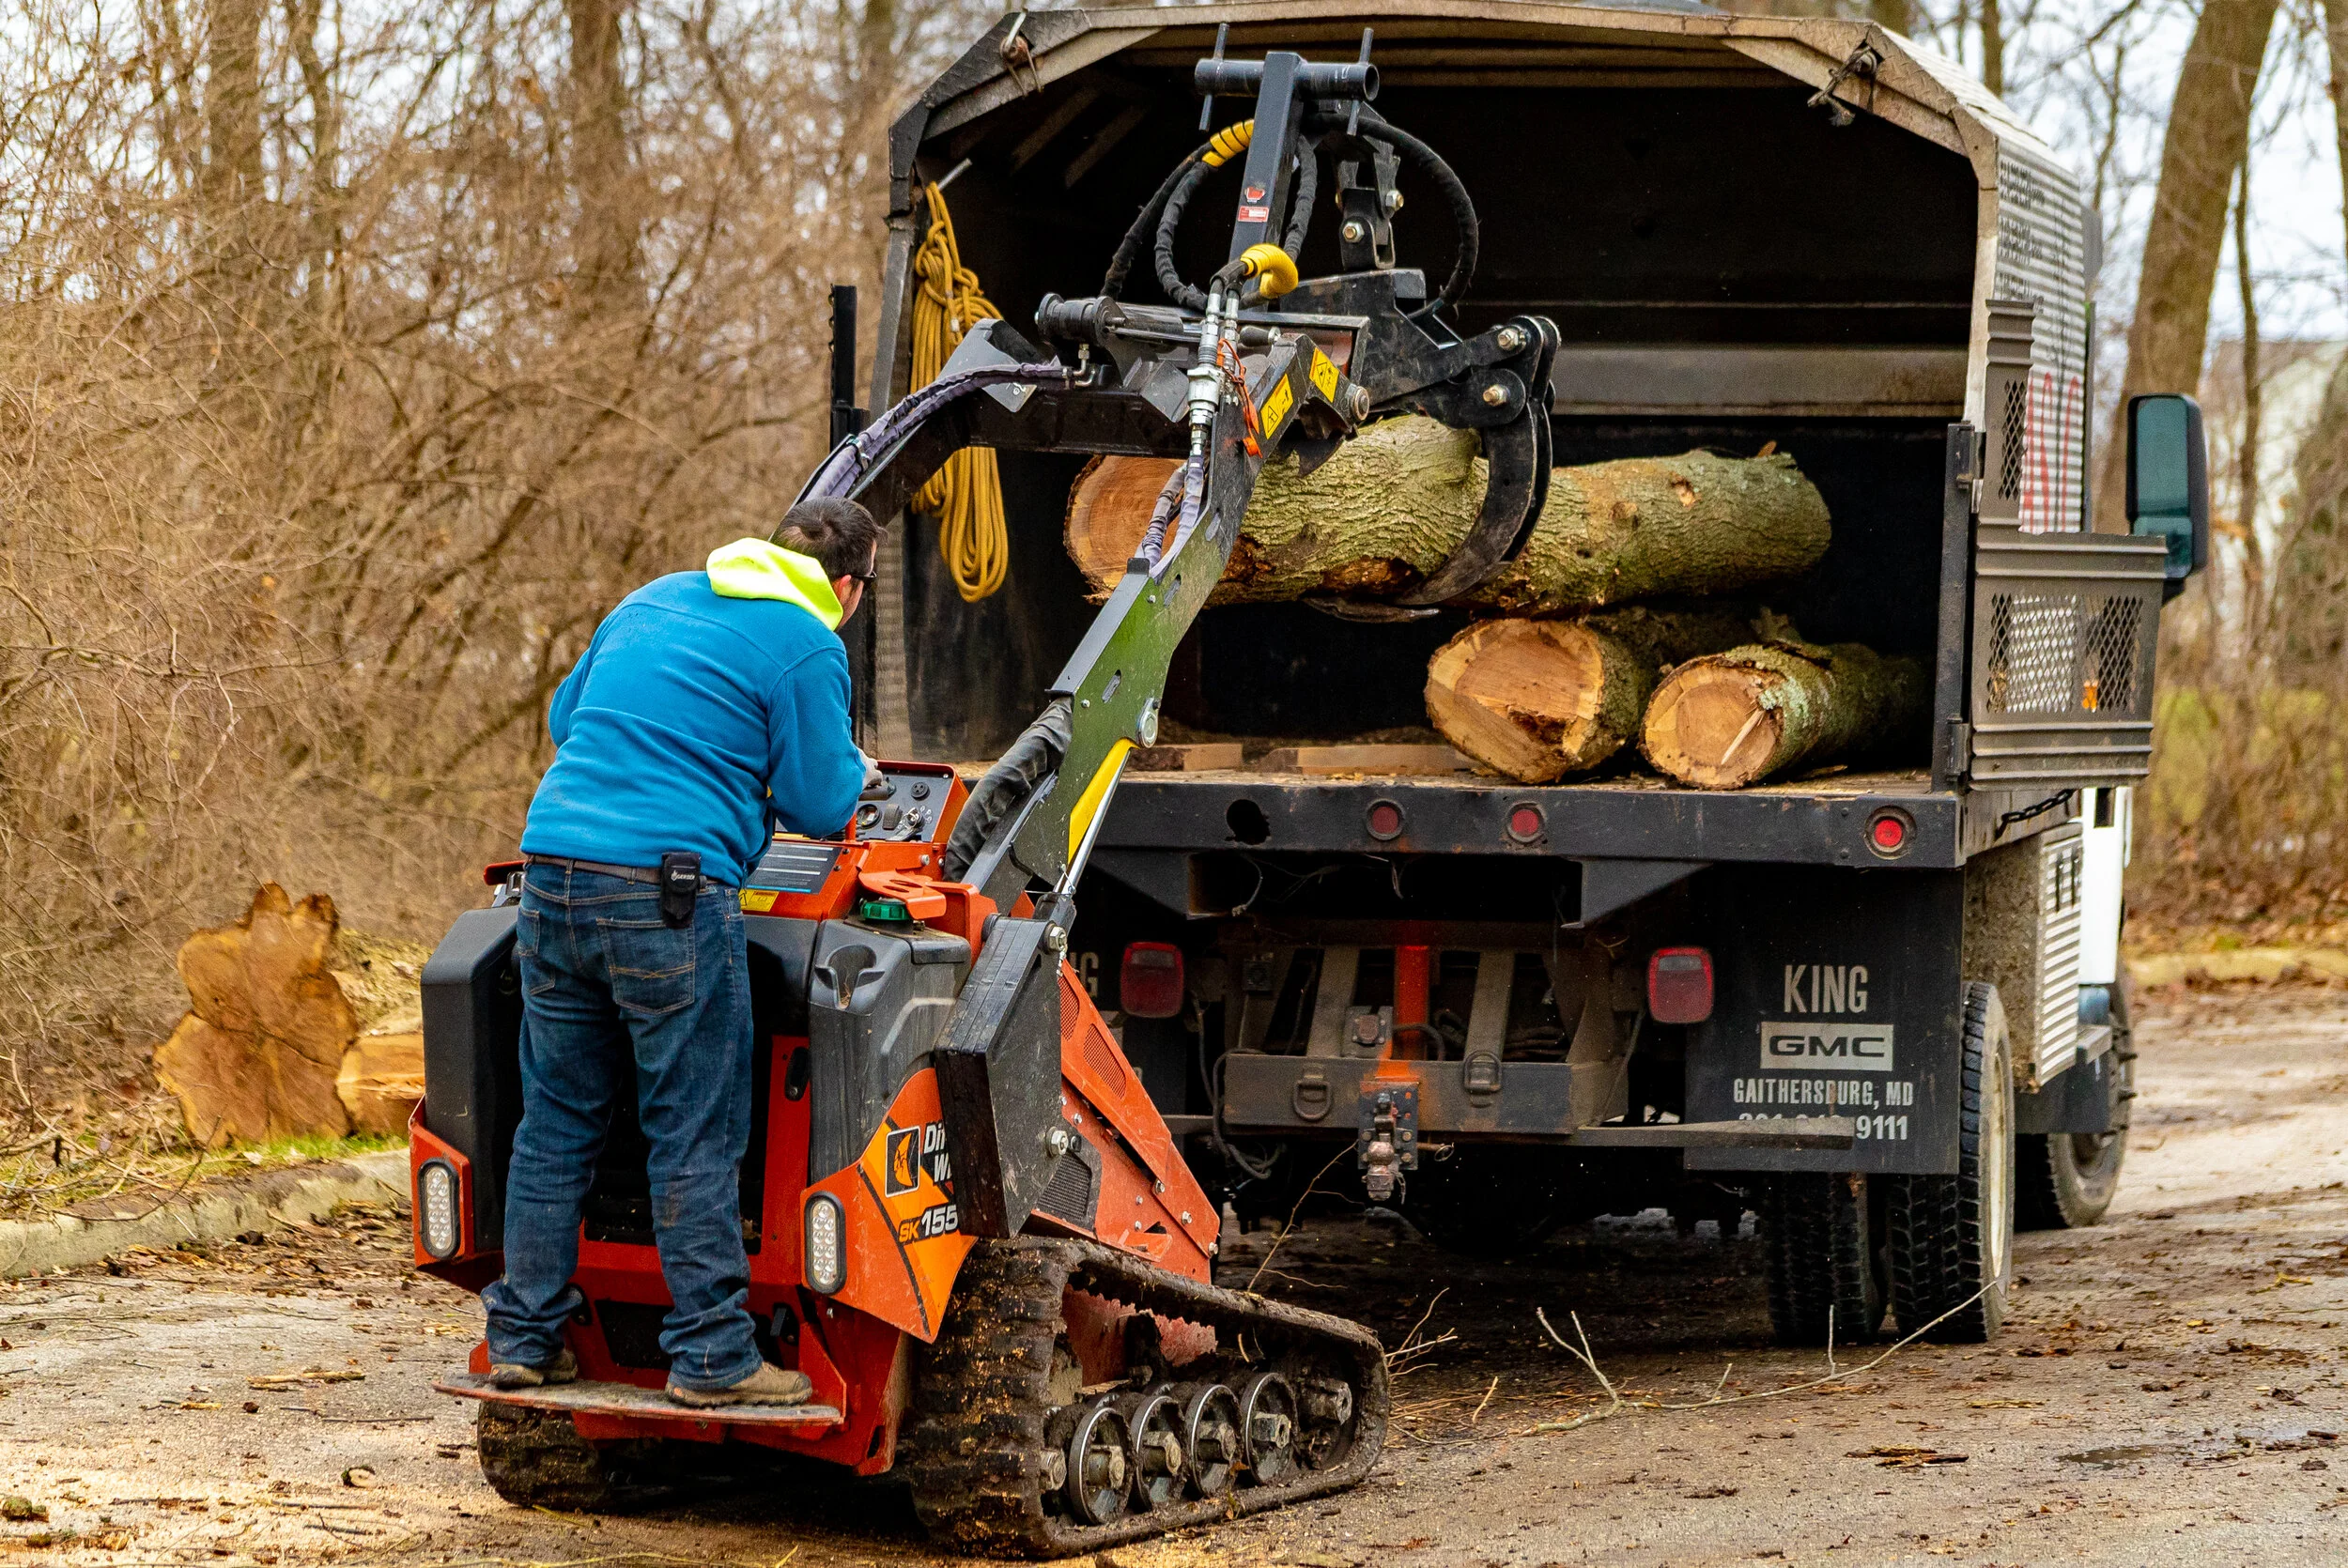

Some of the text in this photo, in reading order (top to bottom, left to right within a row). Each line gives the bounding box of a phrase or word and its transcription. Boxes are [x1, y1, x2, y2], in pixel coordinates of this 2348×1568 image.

[1784, 964, 1869, 1014] KING
[1769, 1035, 1886, 1058] GMC
[1733, 1078, 1914, 1111] GAITHERSBURG, MD
